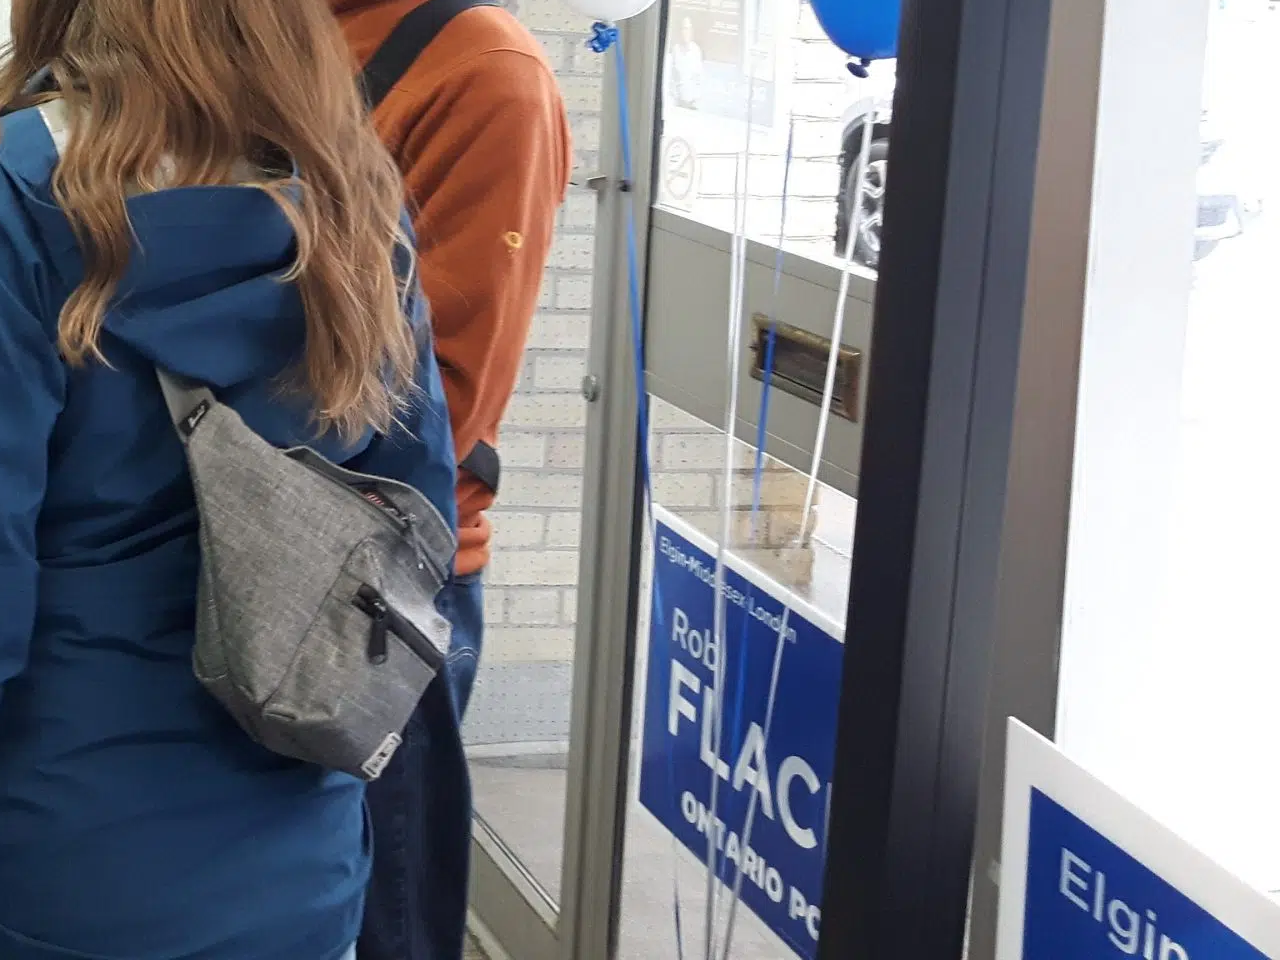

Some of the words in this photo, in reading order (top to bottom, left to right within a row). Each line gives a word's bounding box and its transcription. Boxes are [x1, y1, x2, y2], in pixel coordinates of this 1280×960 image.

[672, 607, 720, 671] Rob
[668, 658, 832, 862] FLAC
[681, 791, 783, 903] ONTARIO
[788, 885, 821, 941] PC
